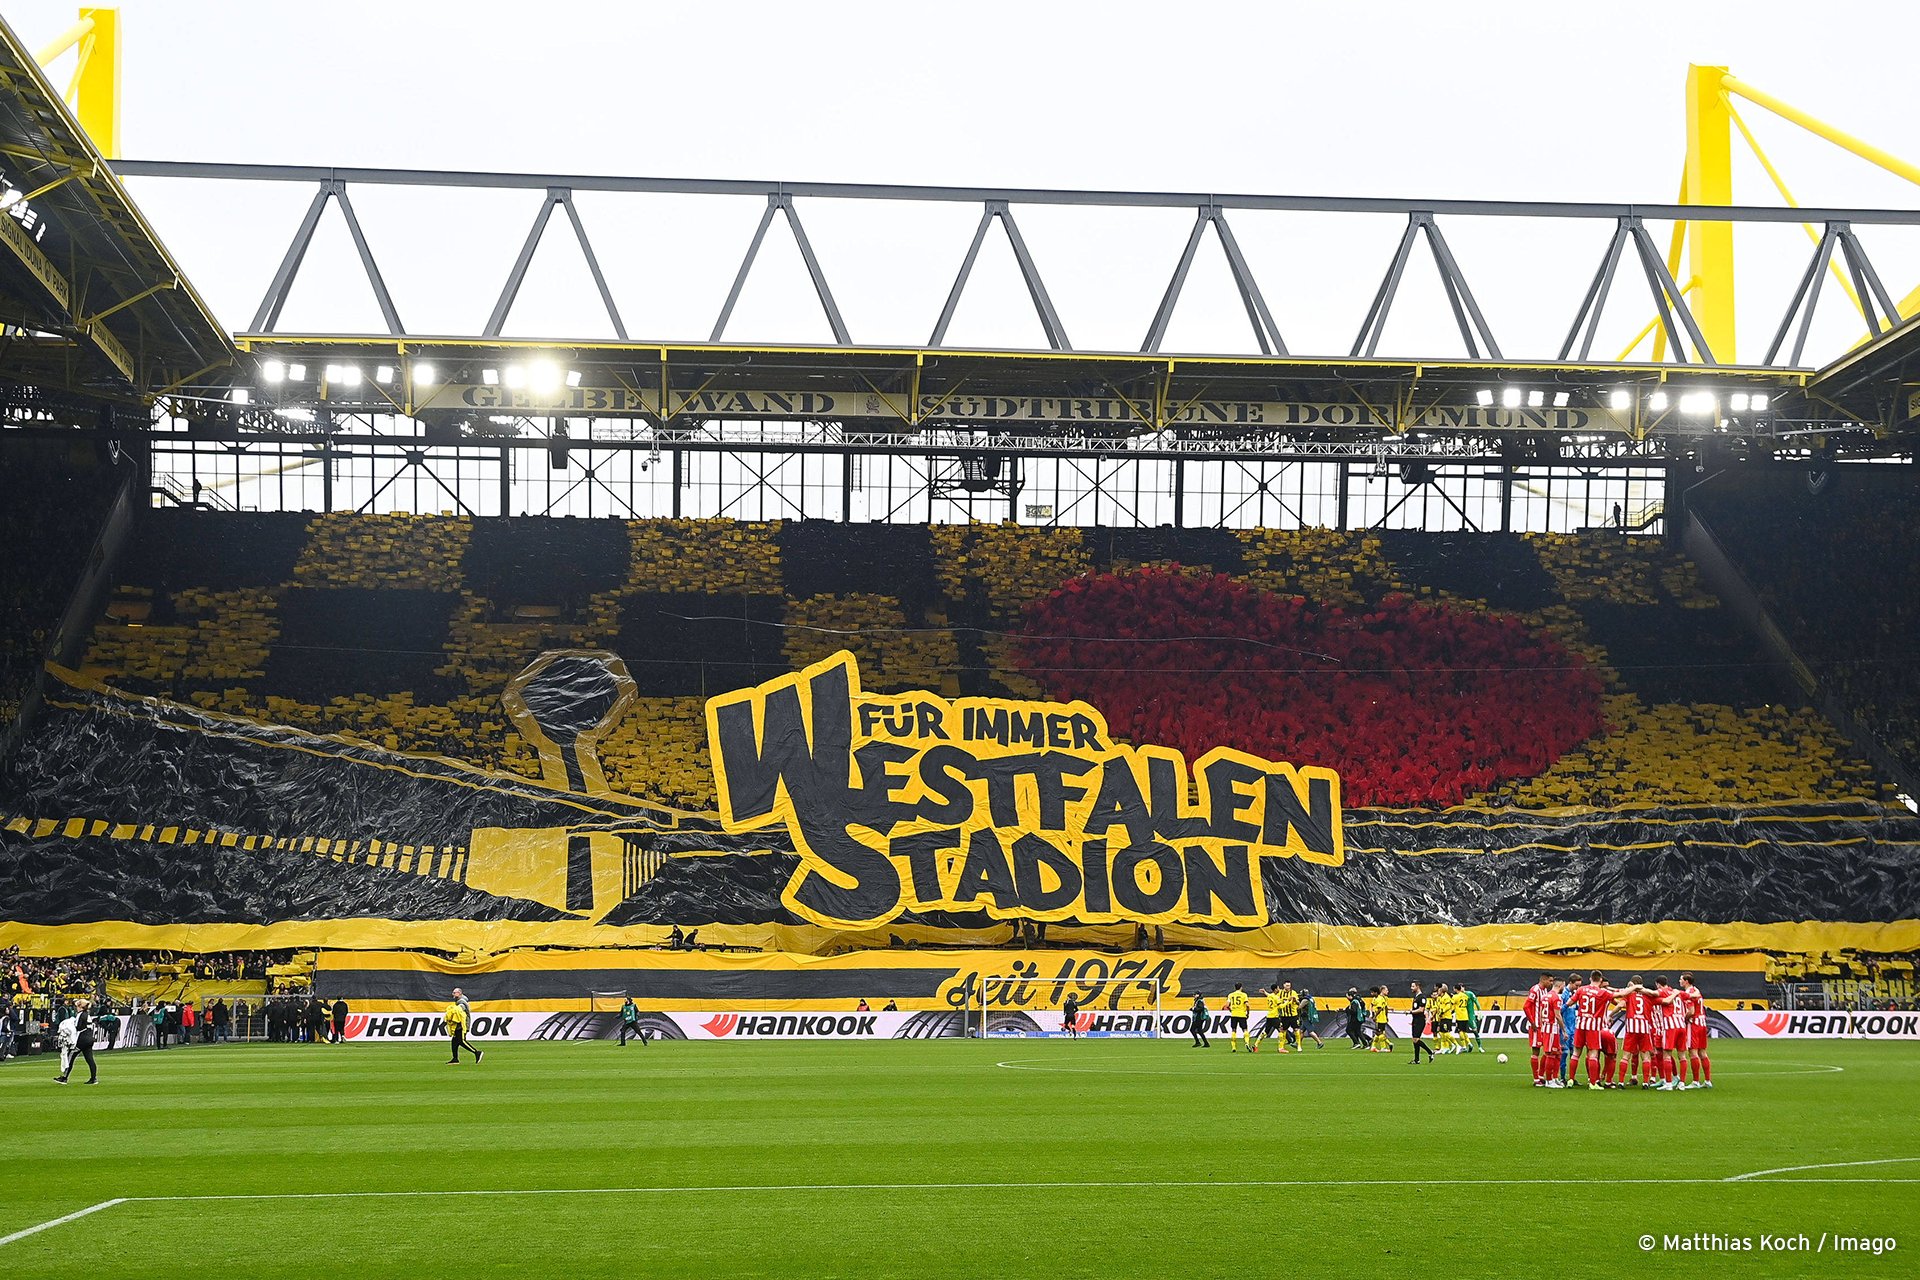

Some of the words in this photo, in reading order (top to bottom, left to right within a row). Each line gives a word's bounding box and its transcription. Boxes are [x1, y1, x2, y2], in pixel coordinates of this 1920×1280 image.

[463, 386, 643, 410] GELBE
[676, 391, 835, 413] WAND
[1287, 402, 1589, 429] DORTMUND
[857, 701, 951, 740] FÜR
[963, 707, 1106, 752] IMMER
[714, 664, 1335, 857] WESTFALEN
[800, 815, 1258, 922] STADION
[947, 959, 1039, 1008] seit
[1050, 957, 1176, 1011] 1974
[1581, 995, 1596, 1014] 31
[1635, 996, 1644, 1015] 3
